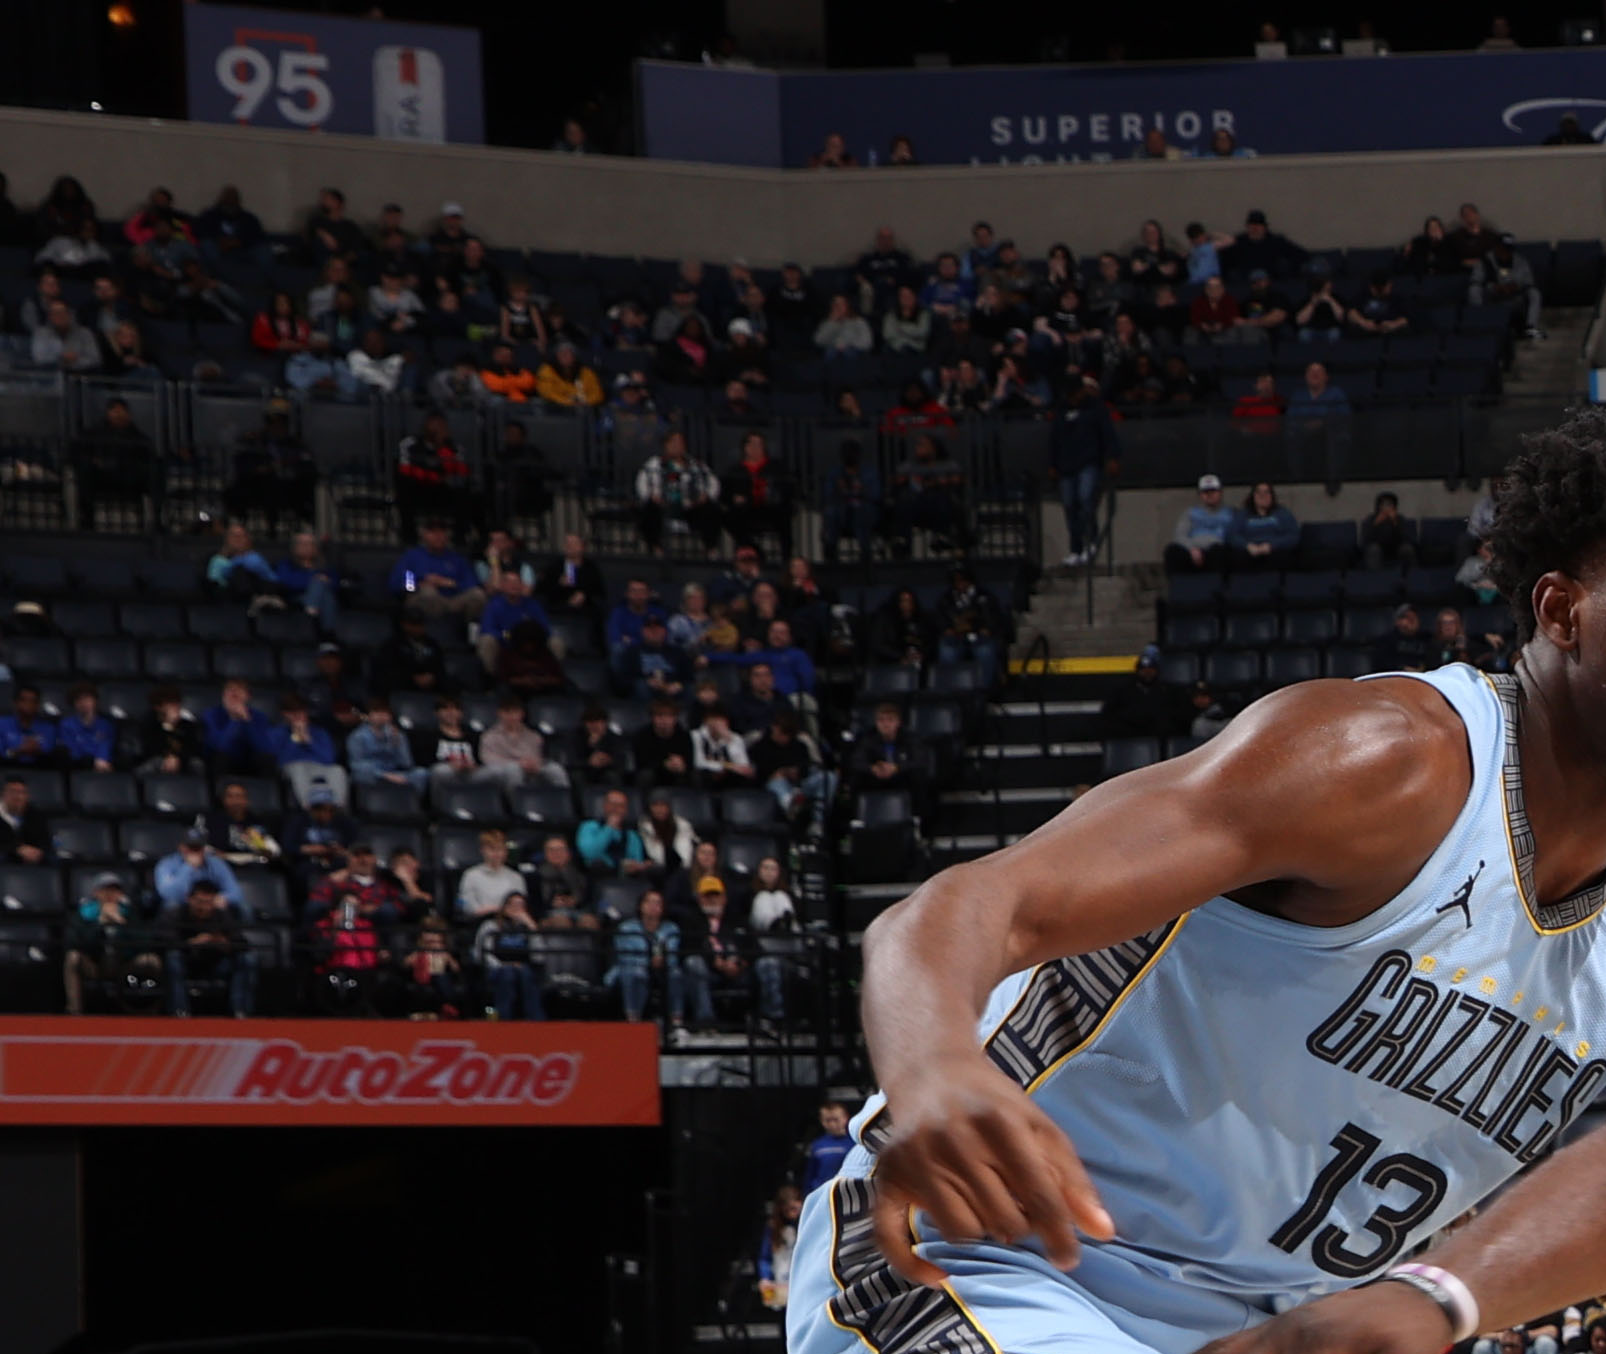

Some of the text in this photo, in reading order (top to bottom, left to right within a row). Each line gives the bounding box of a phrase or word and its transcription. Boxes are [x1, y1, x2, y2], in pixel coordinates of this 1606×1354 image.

[215, 44, 333, 126] 95
[989, 109, 1236, 146] SUPERIOR
[1415, 953, 1592, 1060] MEMPHIS
[235, 1039, 580, 1105] AutoZone
[1268, 1121, 1448, 1279] 13
